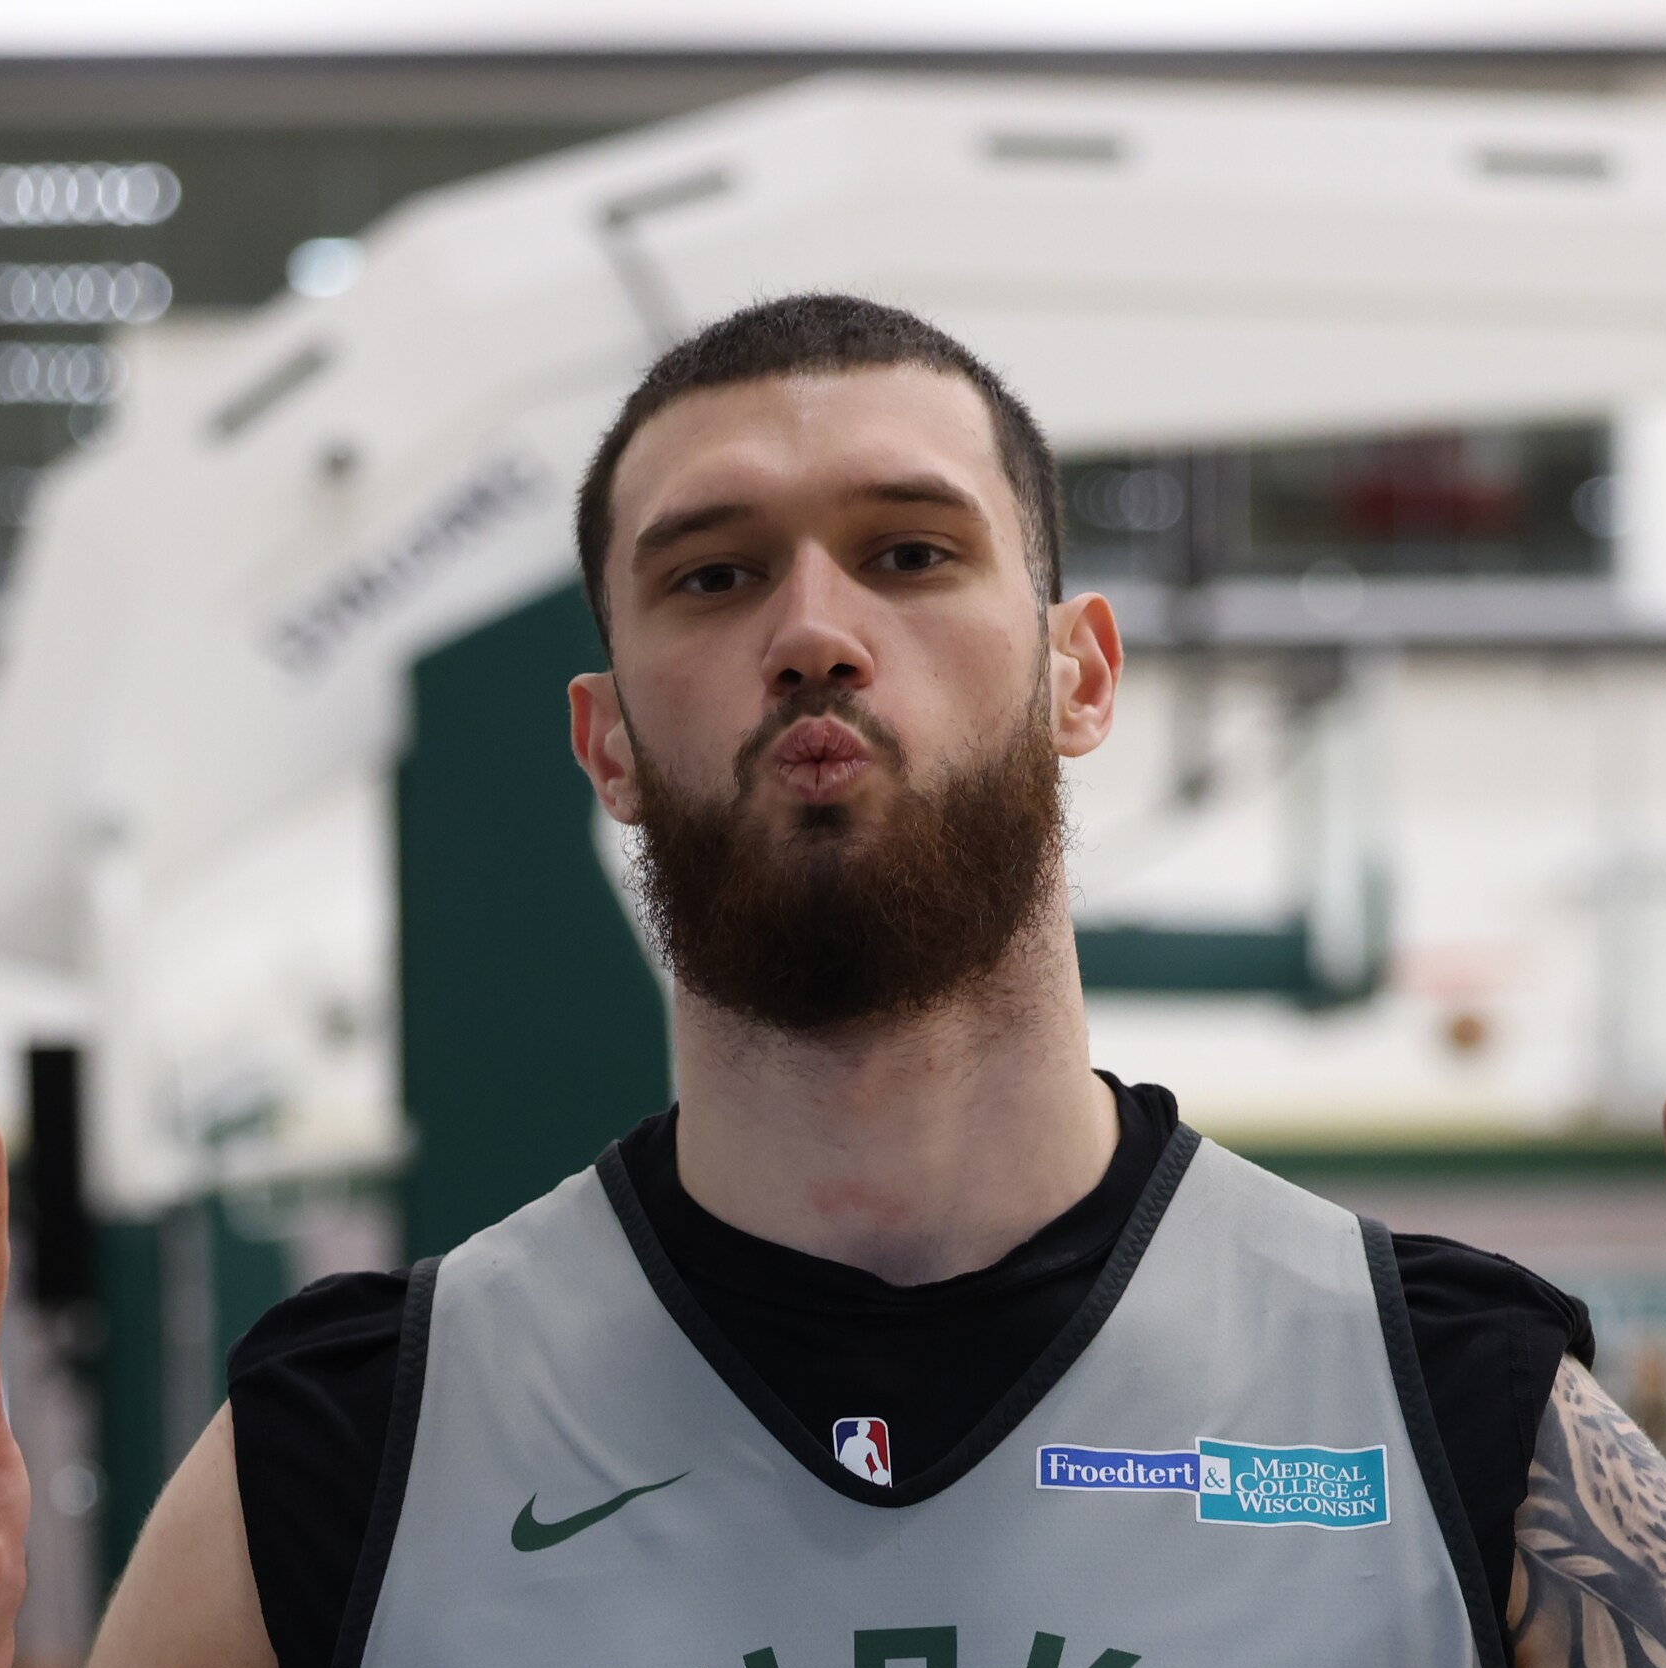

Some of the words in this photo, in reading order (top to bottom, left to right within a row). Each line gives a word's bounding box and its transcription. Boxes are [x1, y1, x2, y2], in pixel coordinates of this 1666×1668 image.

[1047, 1453, 1195, 1486] Froedtert
[1204, 1467, 1227, 1489] &
[1252, 1456, 1367, 1483] MEDICAL
[1235, 1472, 1350, 1499] COLLEGE
[1353, 1484, 1372, 1498] of
[1234, 1490, 1377, 1517] WISCONSIN
